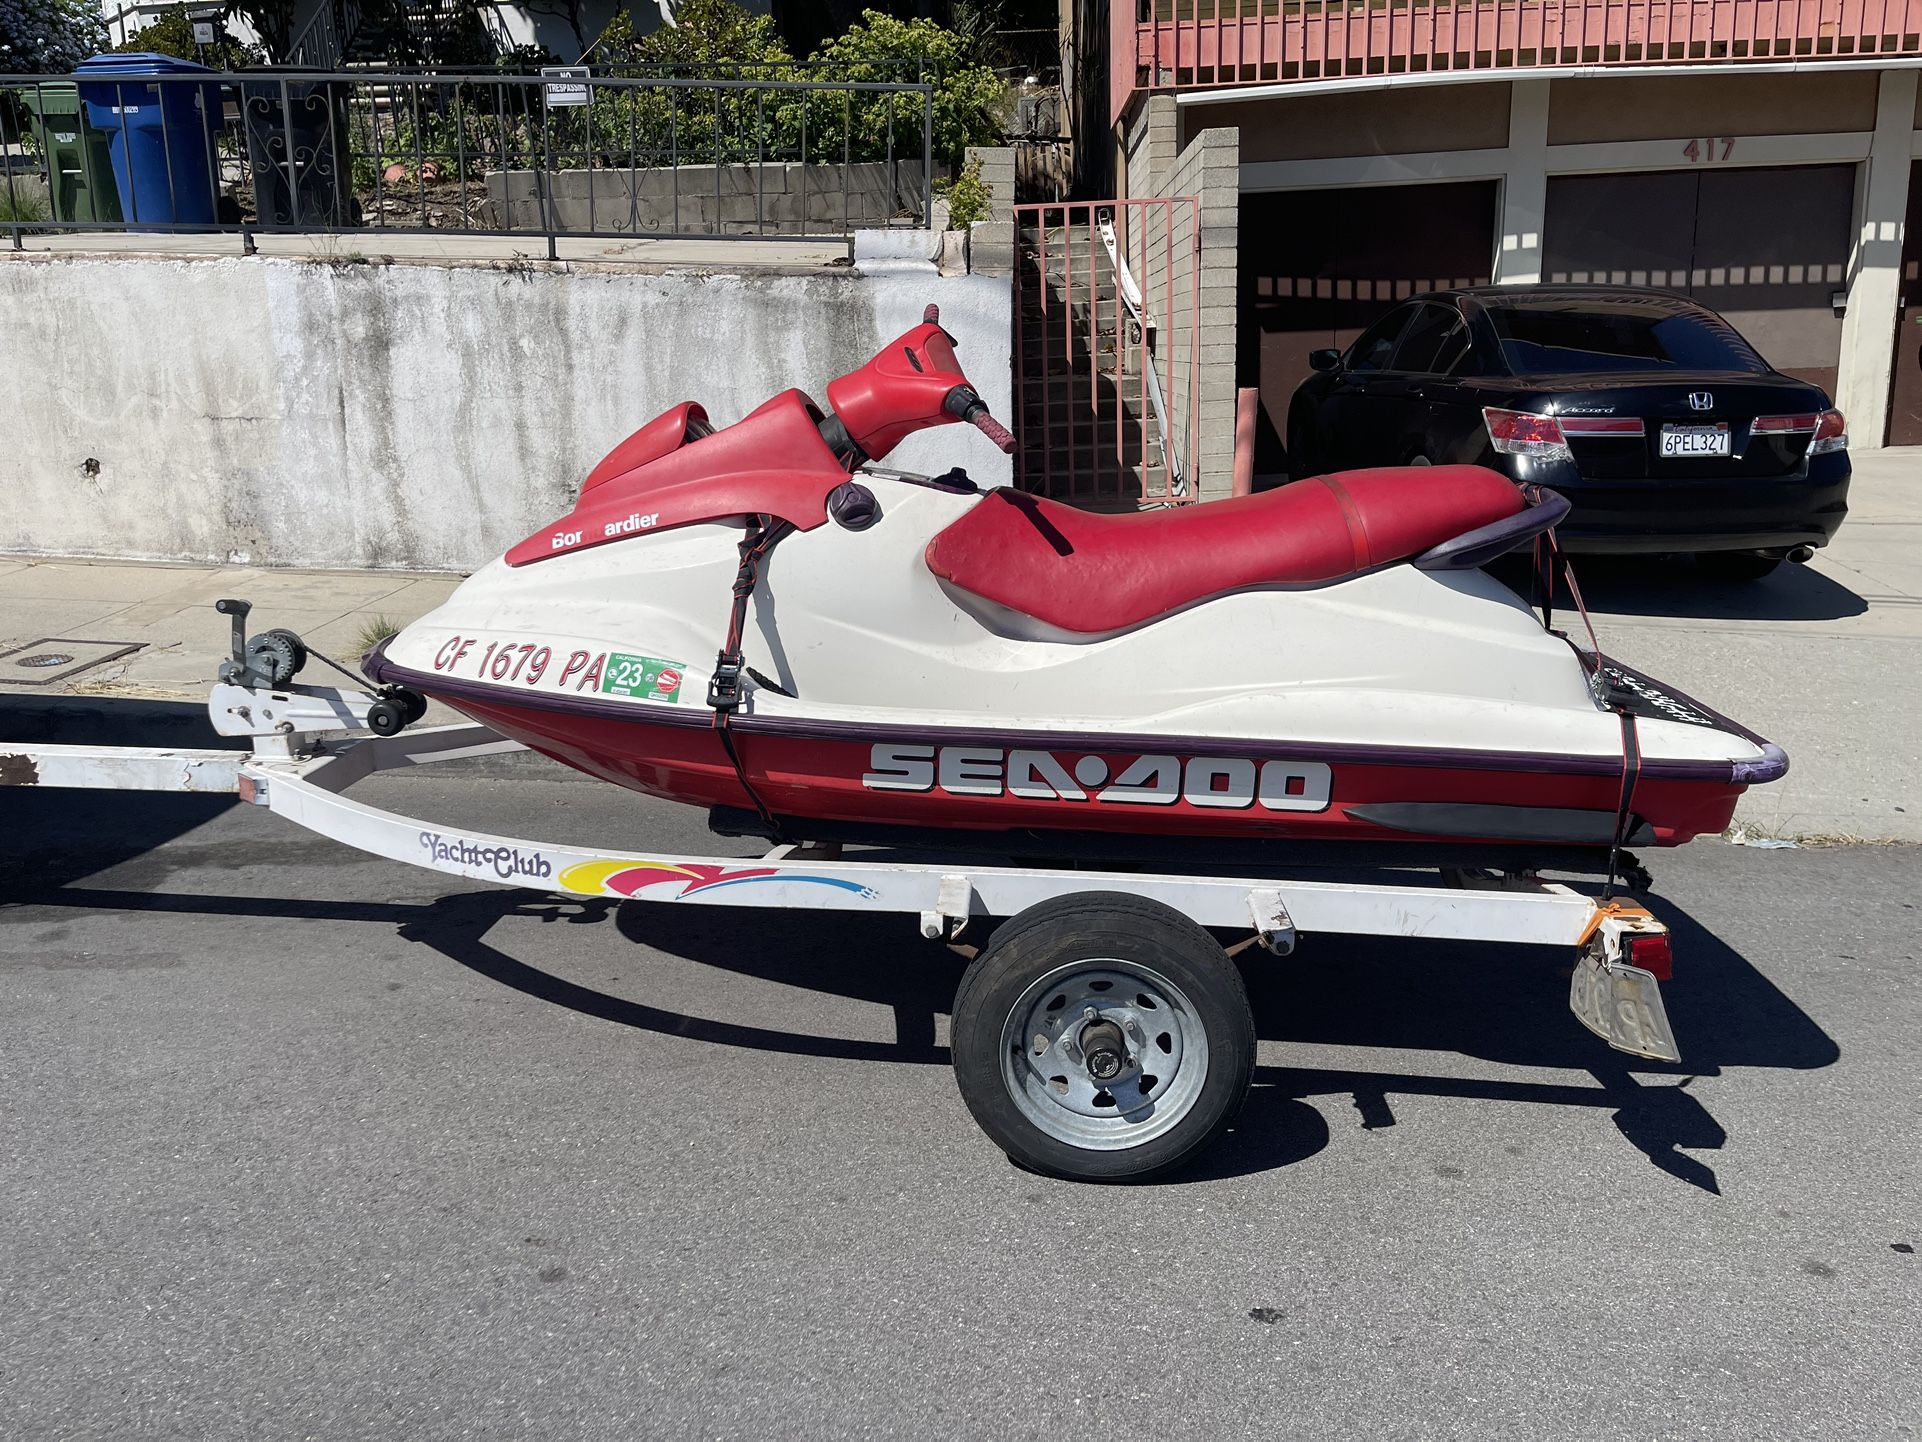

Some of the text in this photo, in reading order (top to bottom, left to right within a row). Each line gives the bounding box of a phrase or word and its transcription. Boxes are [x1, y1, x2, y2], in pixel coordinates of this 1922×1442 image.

[1683, 136, 1735, 162] 417
[1665, 434, 1725, 451] 6PEL327
[604, 513, 659, 536] ardier
[434, 635, 607, 692] CF 1679 PA
[615, 662, 643, 687] 23
